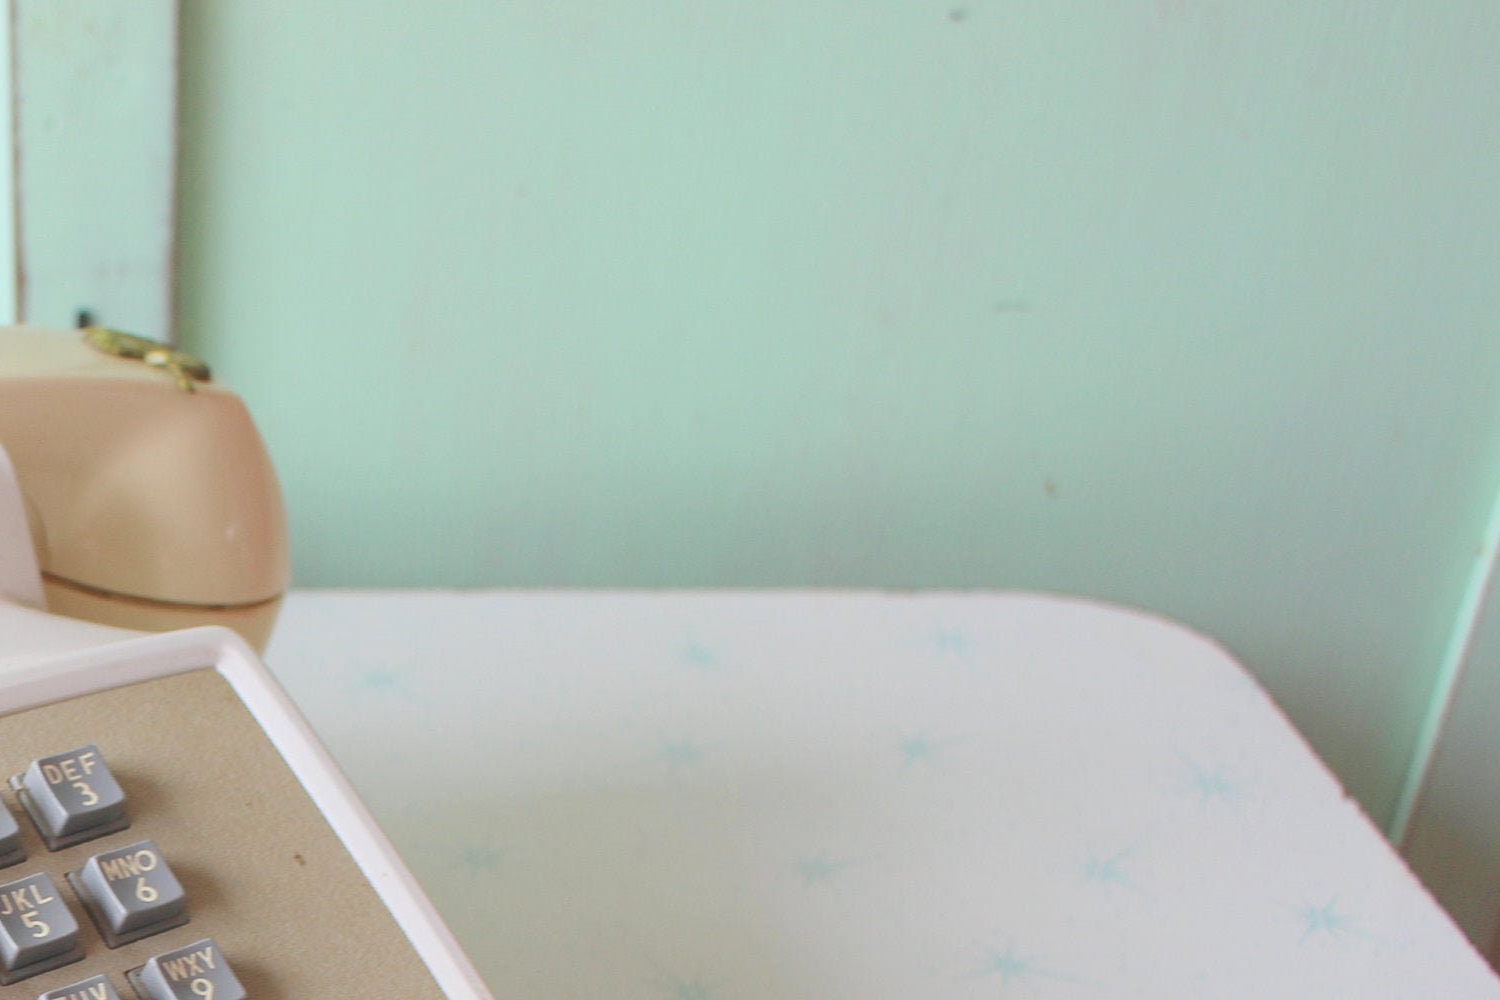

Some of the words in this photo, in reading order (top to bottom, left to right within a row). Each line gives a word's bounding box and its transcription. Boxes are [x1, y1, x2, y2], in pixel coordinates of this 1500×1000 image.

[42, 752, 97, 785] DEF
[72, 781, 98, 807] 3
[101, 849, 158, 882] MNO
[0, 884, 54, 916] JKL
[135, 877, 158, 902] 6
[21, 911, 51, 939] 5
[161, 948, 215, 983] WXY
